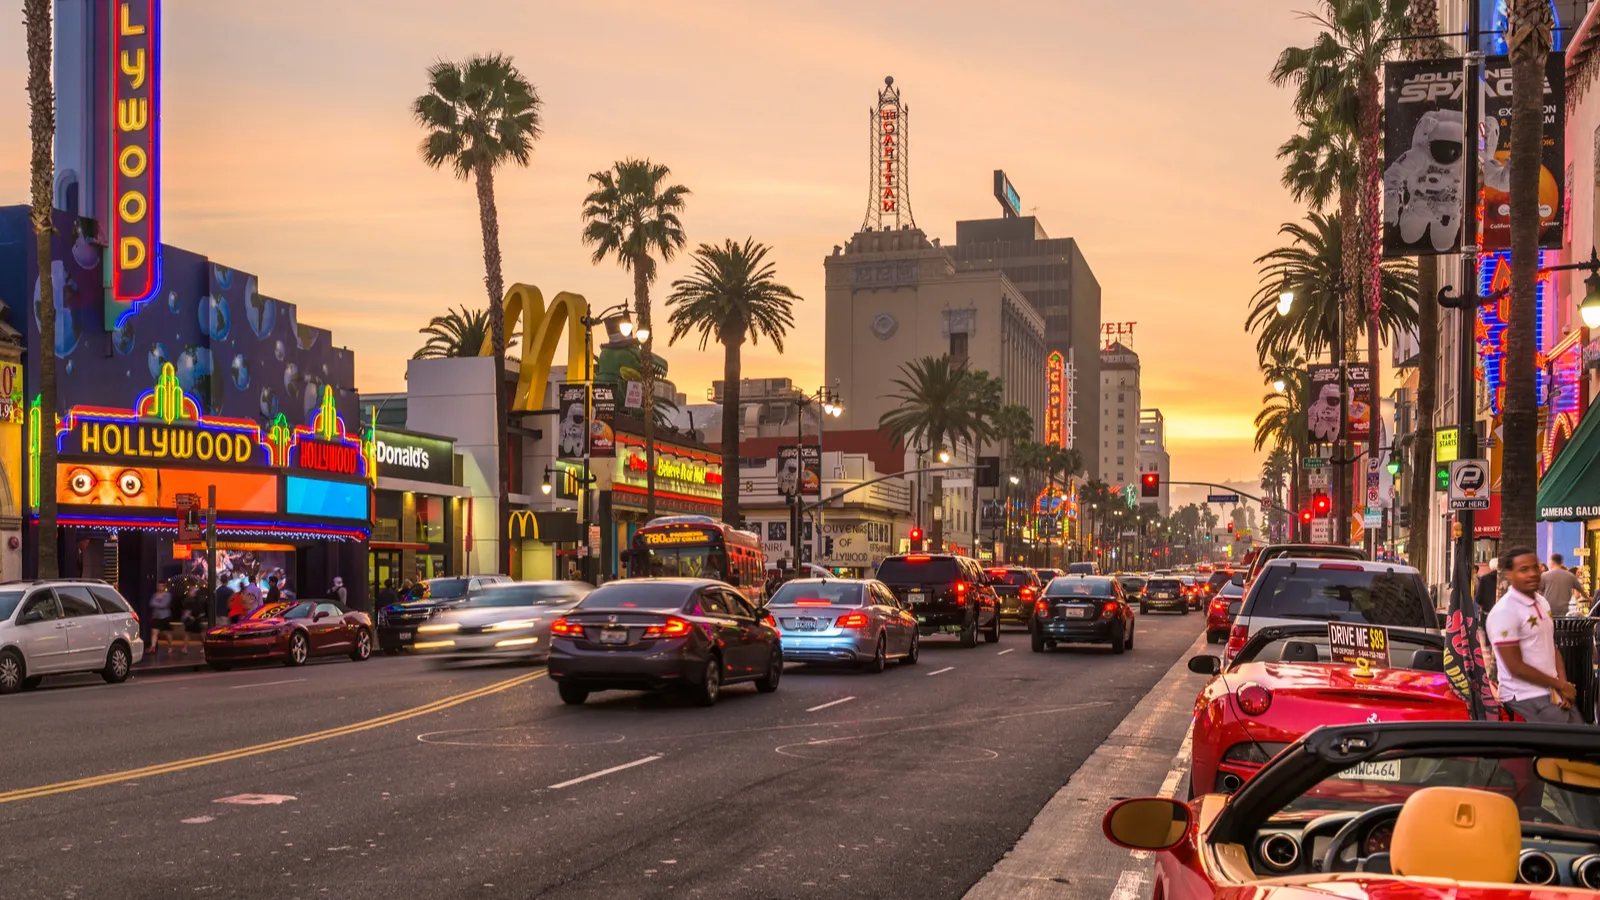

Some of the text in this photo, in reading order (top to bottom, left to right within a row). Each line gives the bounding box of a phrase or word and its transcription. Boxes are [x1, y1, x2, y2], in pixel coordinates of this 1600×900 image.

[1404, 68, 1513, 84] JOURNE
[1397, 77, 1553, 104] SPAC
[118, 3, 147, 269] LYWOOD
[882, 120, 895, 211] CAPITAN
[562, 392, 614, 401] SPACE
[82, 422, 252, 463] HOLLYWOOD
[1439, 440, 1457, 448] STARTS
[300, 440, 357, 474] HOLLYWOOD
[1468, 500, 1487, 508] HERE
[1541, 506, 1573, 517] CAMERAS
[822, 524, 868, 534] OUVENIRS
[645, 533, 668, 544] 780
[839, 538, 853, 547] OF
[1330, 625, 1385, 651] DRIVE ME $89
